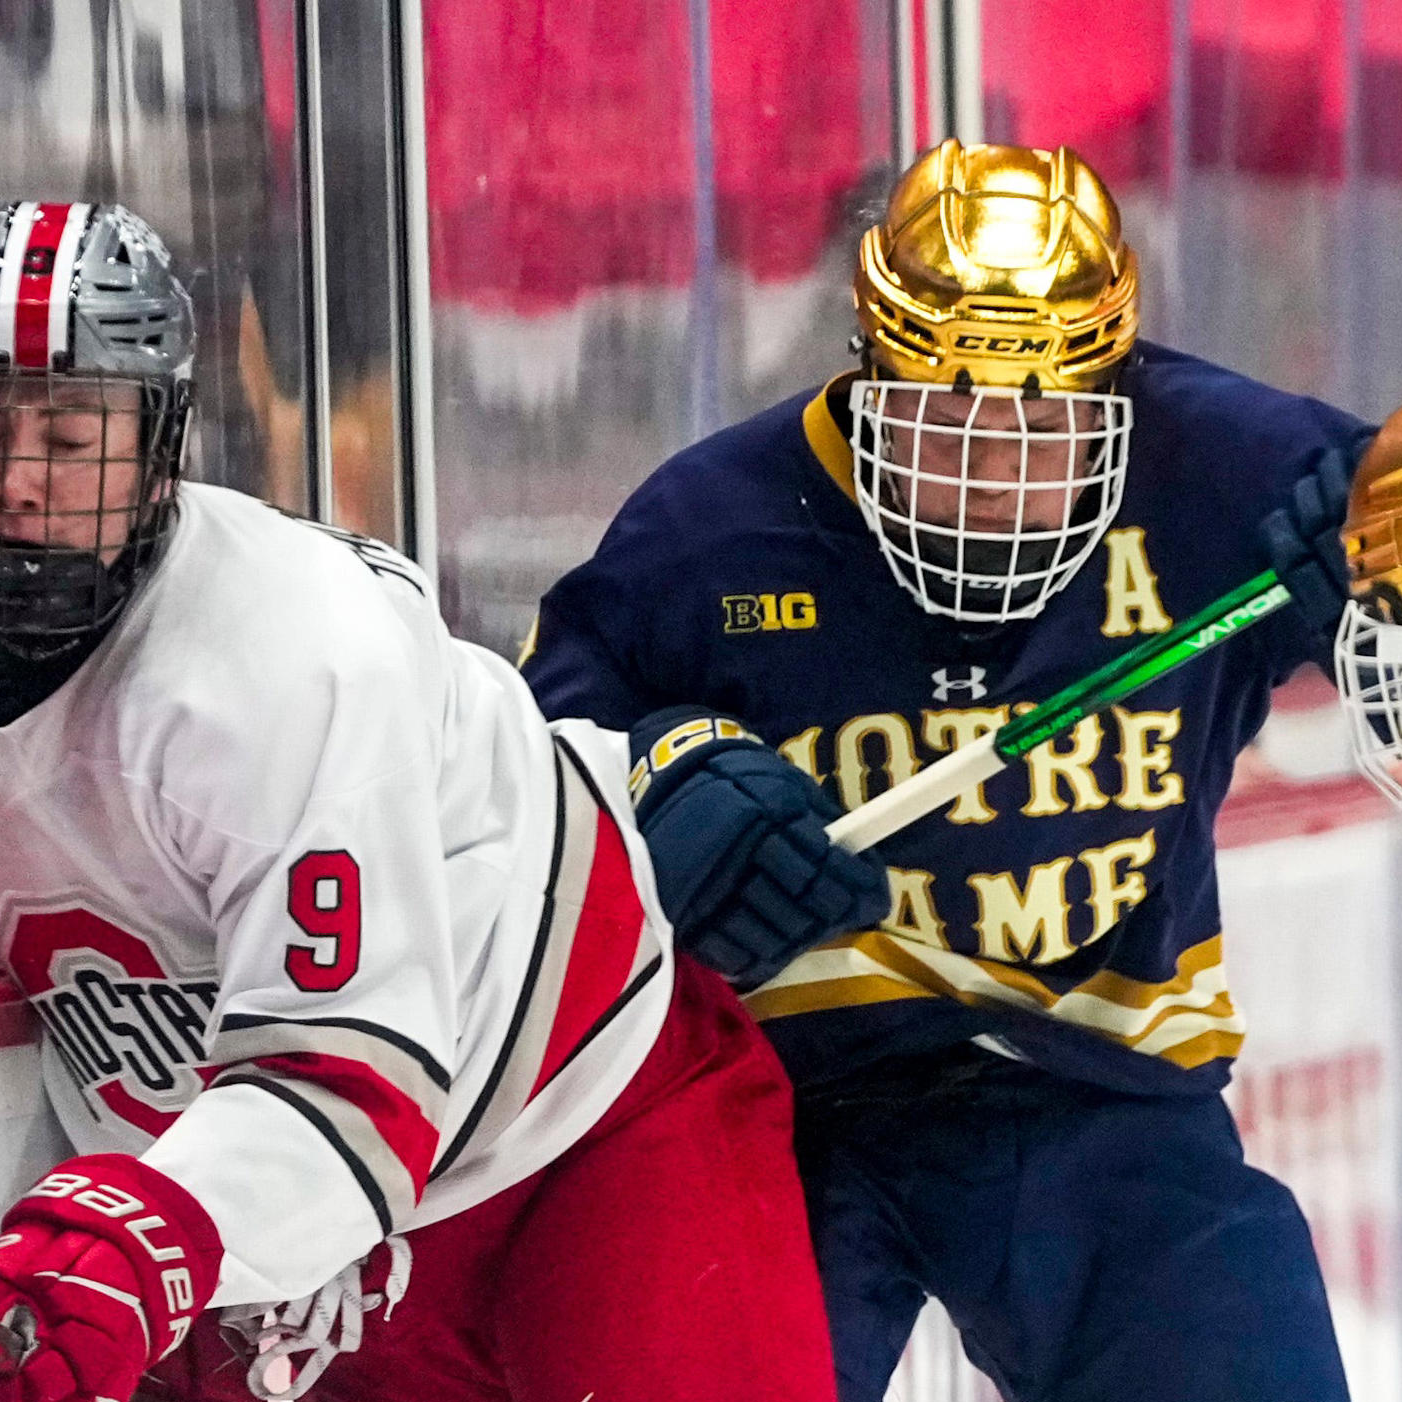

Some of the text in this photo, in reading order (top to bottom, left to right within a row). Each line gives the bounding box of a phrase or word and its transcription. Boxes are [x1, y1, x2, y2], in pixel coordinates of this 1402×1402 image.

[953, 334, 1050, 354] CCM
[1100, 526, 1173, 638] A
[284, 849, 362, 993] 9
[882, 827, 1157, 966] AME
